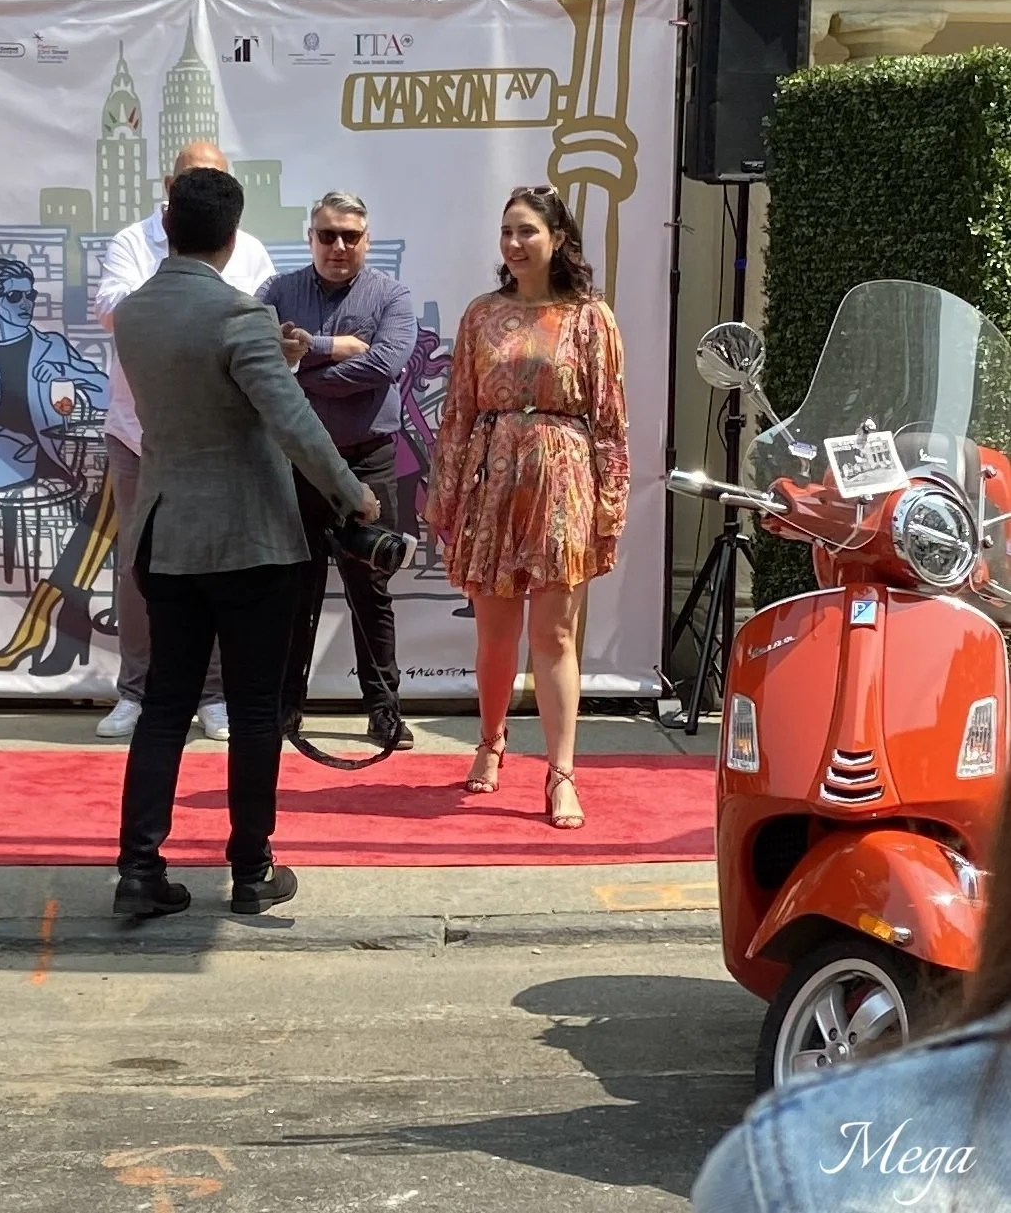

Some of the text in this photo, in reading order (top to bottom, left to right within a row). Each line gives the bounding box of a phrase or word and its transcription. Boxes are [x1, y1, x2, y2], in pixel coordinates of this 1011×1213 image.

[353, 33, 404, 57] ITA
[363, 72, 545, 124] MADISON AV
[406, 667, 477, 679] GALLOTTA
